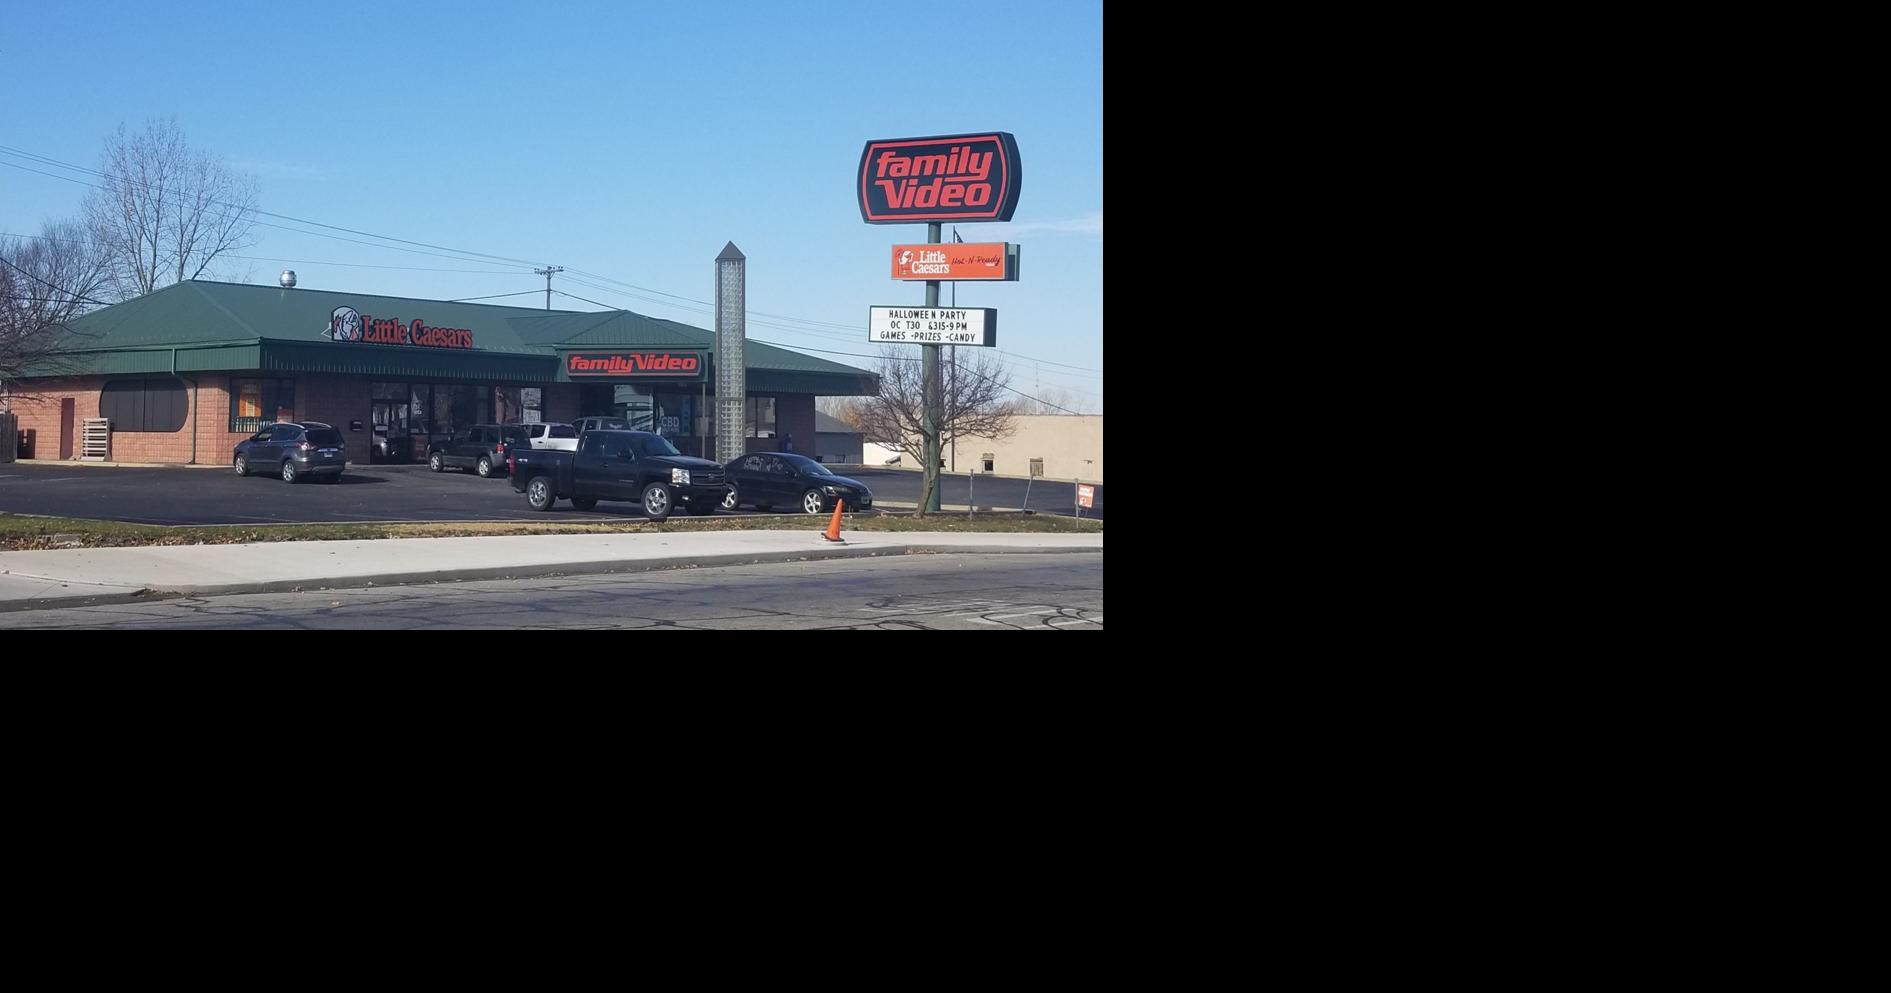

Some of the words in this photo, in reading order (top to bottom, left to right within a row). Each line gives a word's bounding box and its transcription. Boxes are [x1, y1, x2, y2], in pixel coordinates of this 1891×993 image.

[876, 146, 993, 182] family
[874, 177, 992, 209] Video
[919, 250, 946, 264] Little
[911, 261, 950, 274] Caesars
[940, 311, 967, 320] PARTY
[361, 315, 408, 345] Little
[409, 319, 473, 349] Caesars
[880, 330, 906, 340] GAMES
[570, 355, 633, 374] family
[630, 352, 697, 370] Video
[661, 416, 680, 428] CBD
